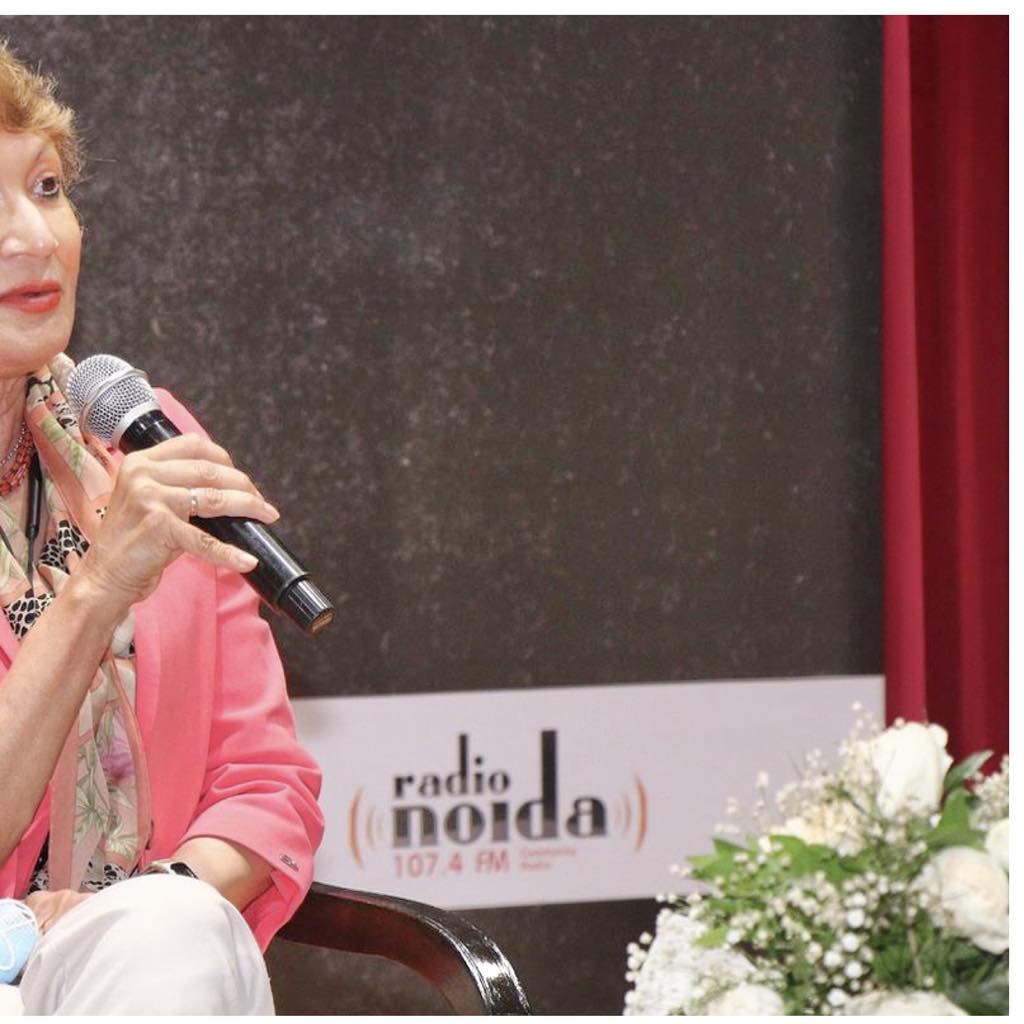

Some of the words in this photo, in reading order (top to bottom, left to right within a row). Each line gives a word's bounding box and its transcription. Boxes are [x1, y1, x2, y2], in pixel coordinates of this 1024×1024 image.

[392, 729, 607, 848] noida
[393, 733, 511, 799] radio
[393, 851, 463, 878] 107.4
[476, 849, 510, 874] FM
